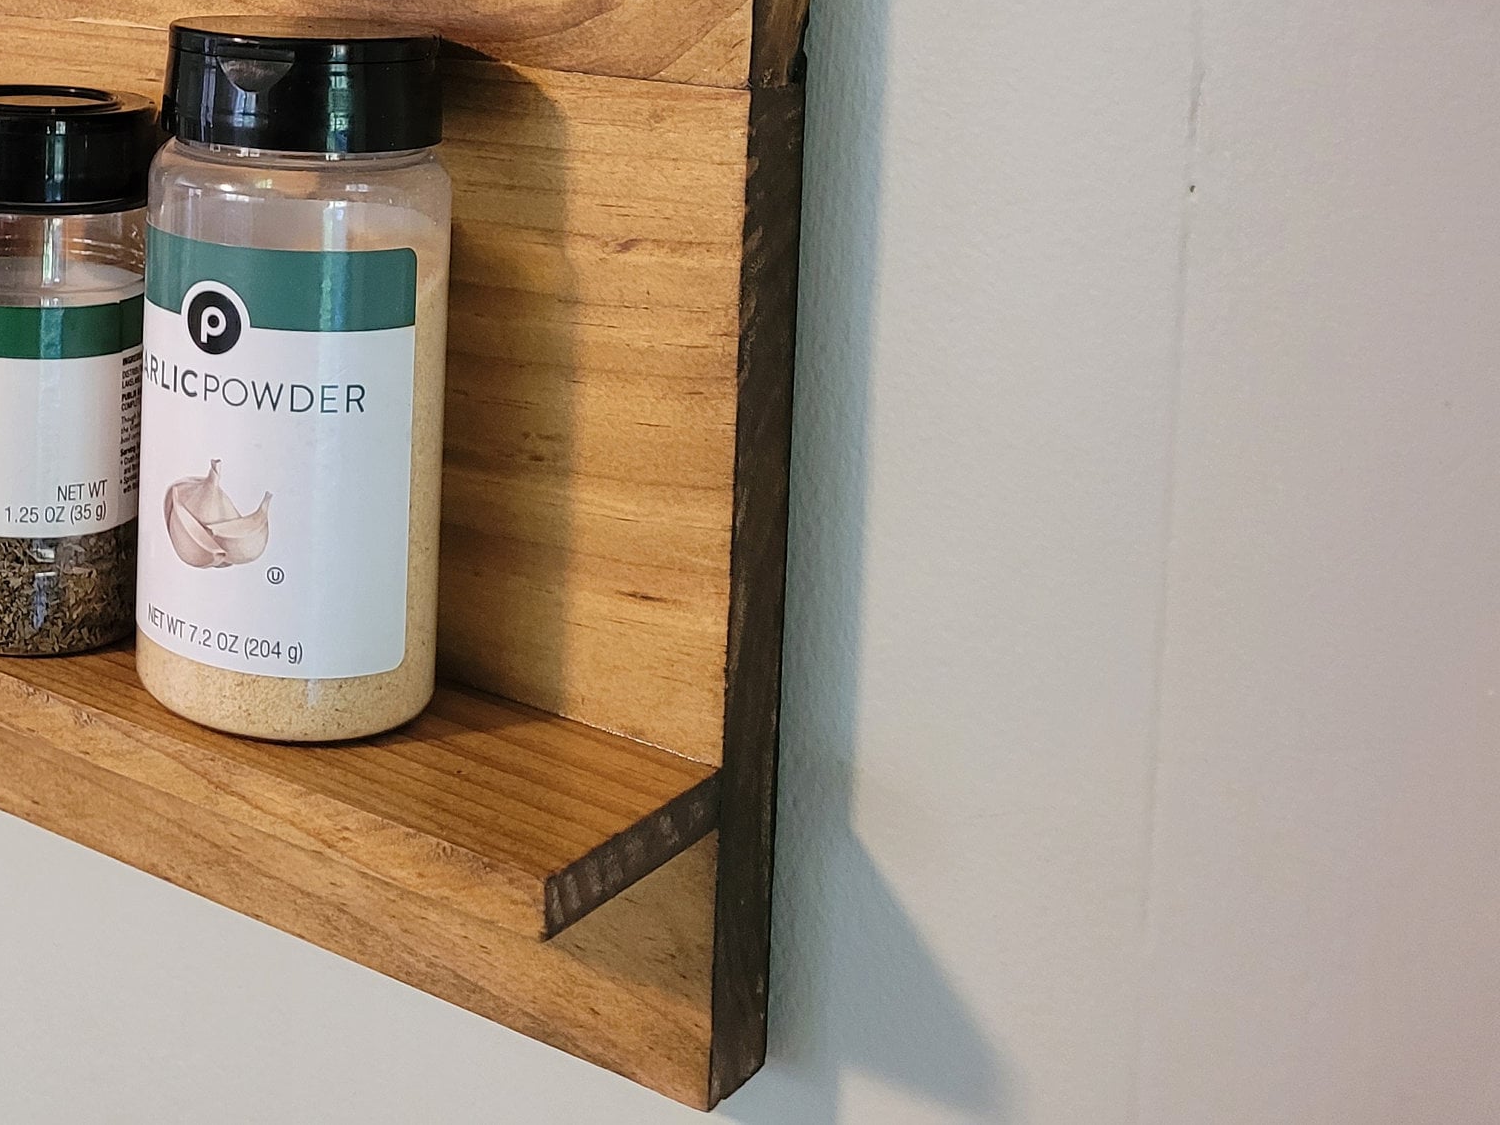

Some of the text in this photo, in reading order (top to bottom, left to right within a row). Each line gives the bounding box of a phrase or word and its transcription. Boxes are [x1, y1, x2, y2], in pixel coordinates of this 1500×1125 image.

[57, 479, 108, 502] NET WT
[5, 501, 107, 525] 1.25 OZ (35 g)
[148, 602, 303, 664] NET WT 7.2 OZ (204 g)
